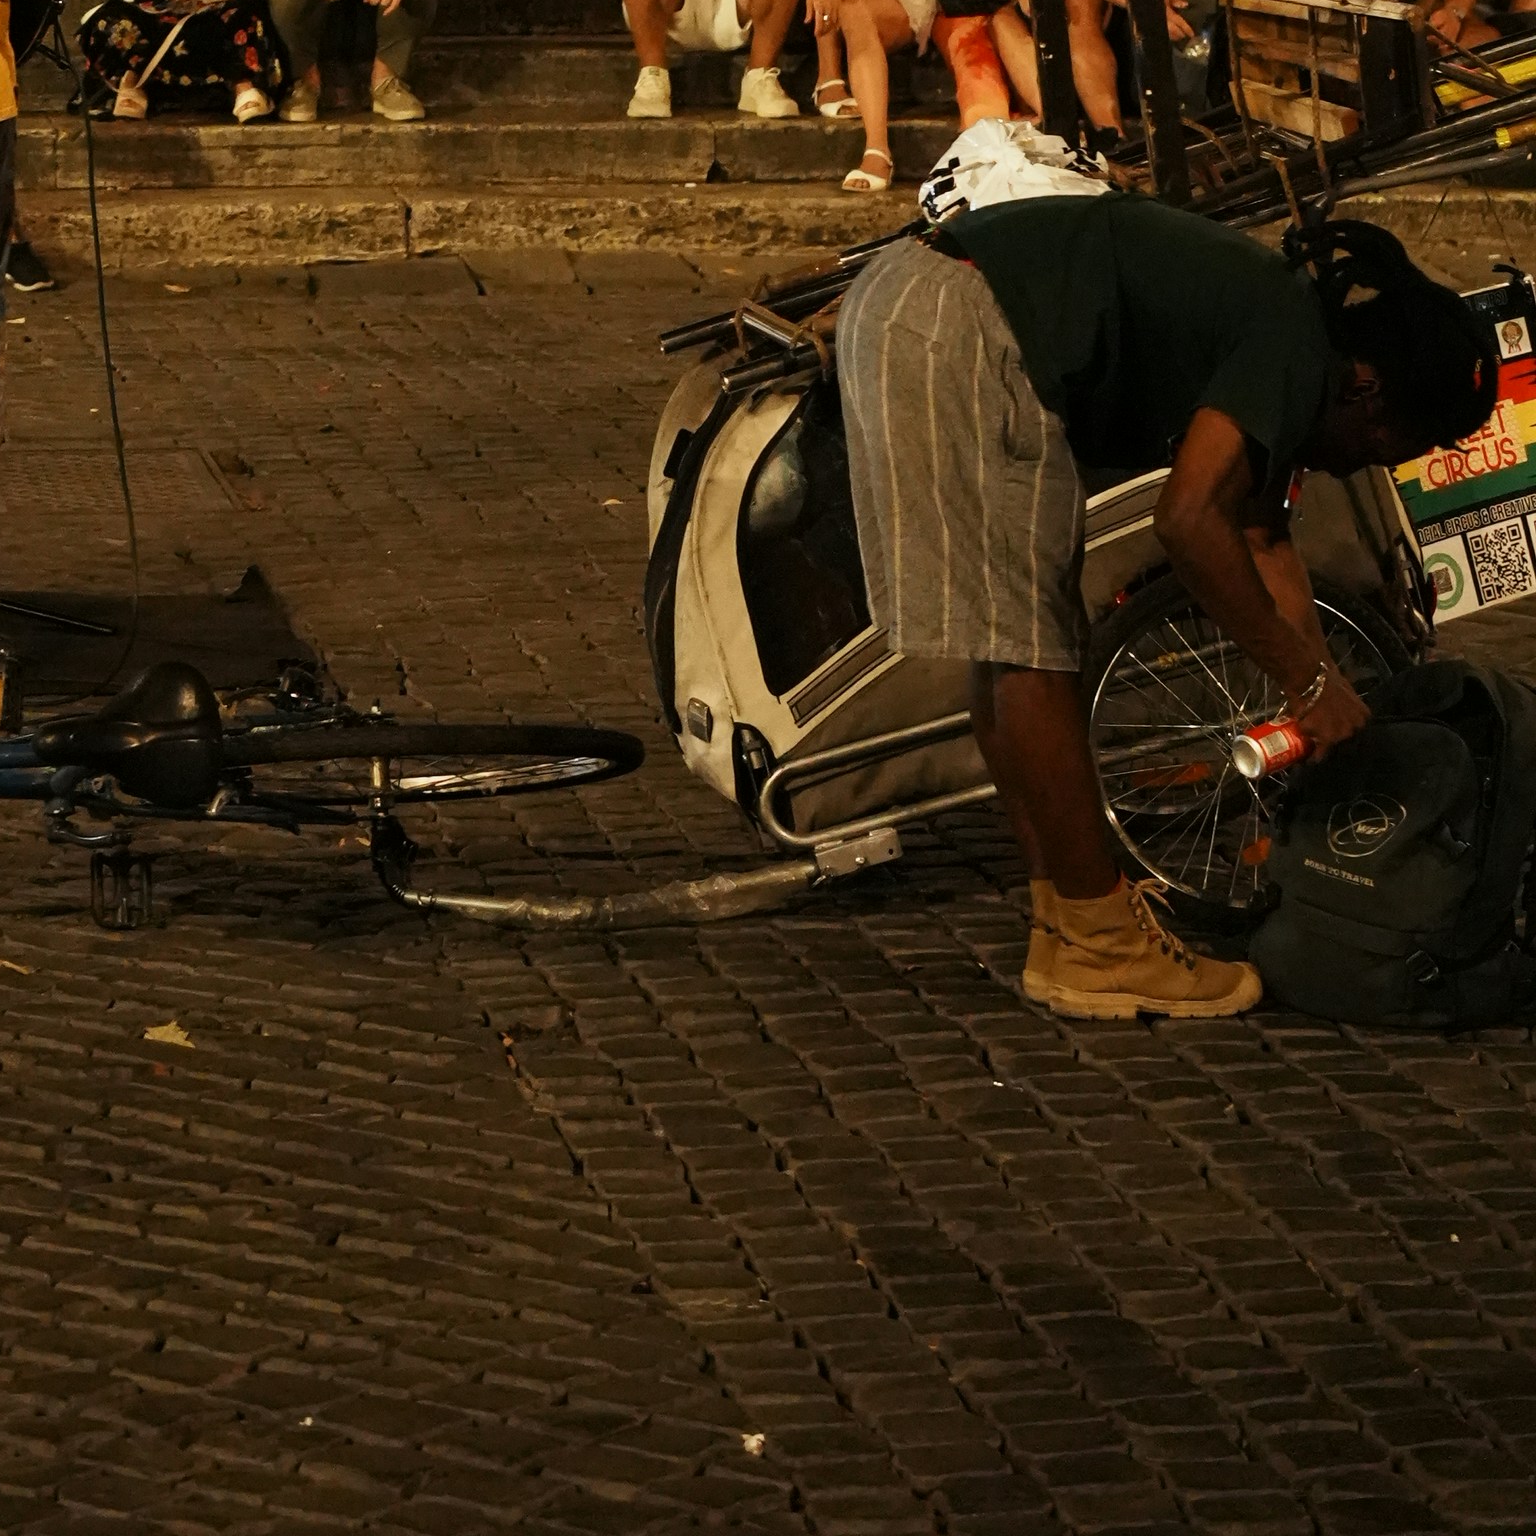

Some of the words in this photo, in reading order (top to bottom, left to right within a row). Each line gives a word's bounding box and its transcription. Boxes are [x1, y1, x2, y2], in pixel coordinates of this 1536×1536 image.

[1427, 437, 1518, 488] CIRCUS
[1417, 522, 1446, 545] OCIAL
[1443, 510, 1481, 537] CIRCUS
[1340, 869, 1376, 888] TRAVEL
